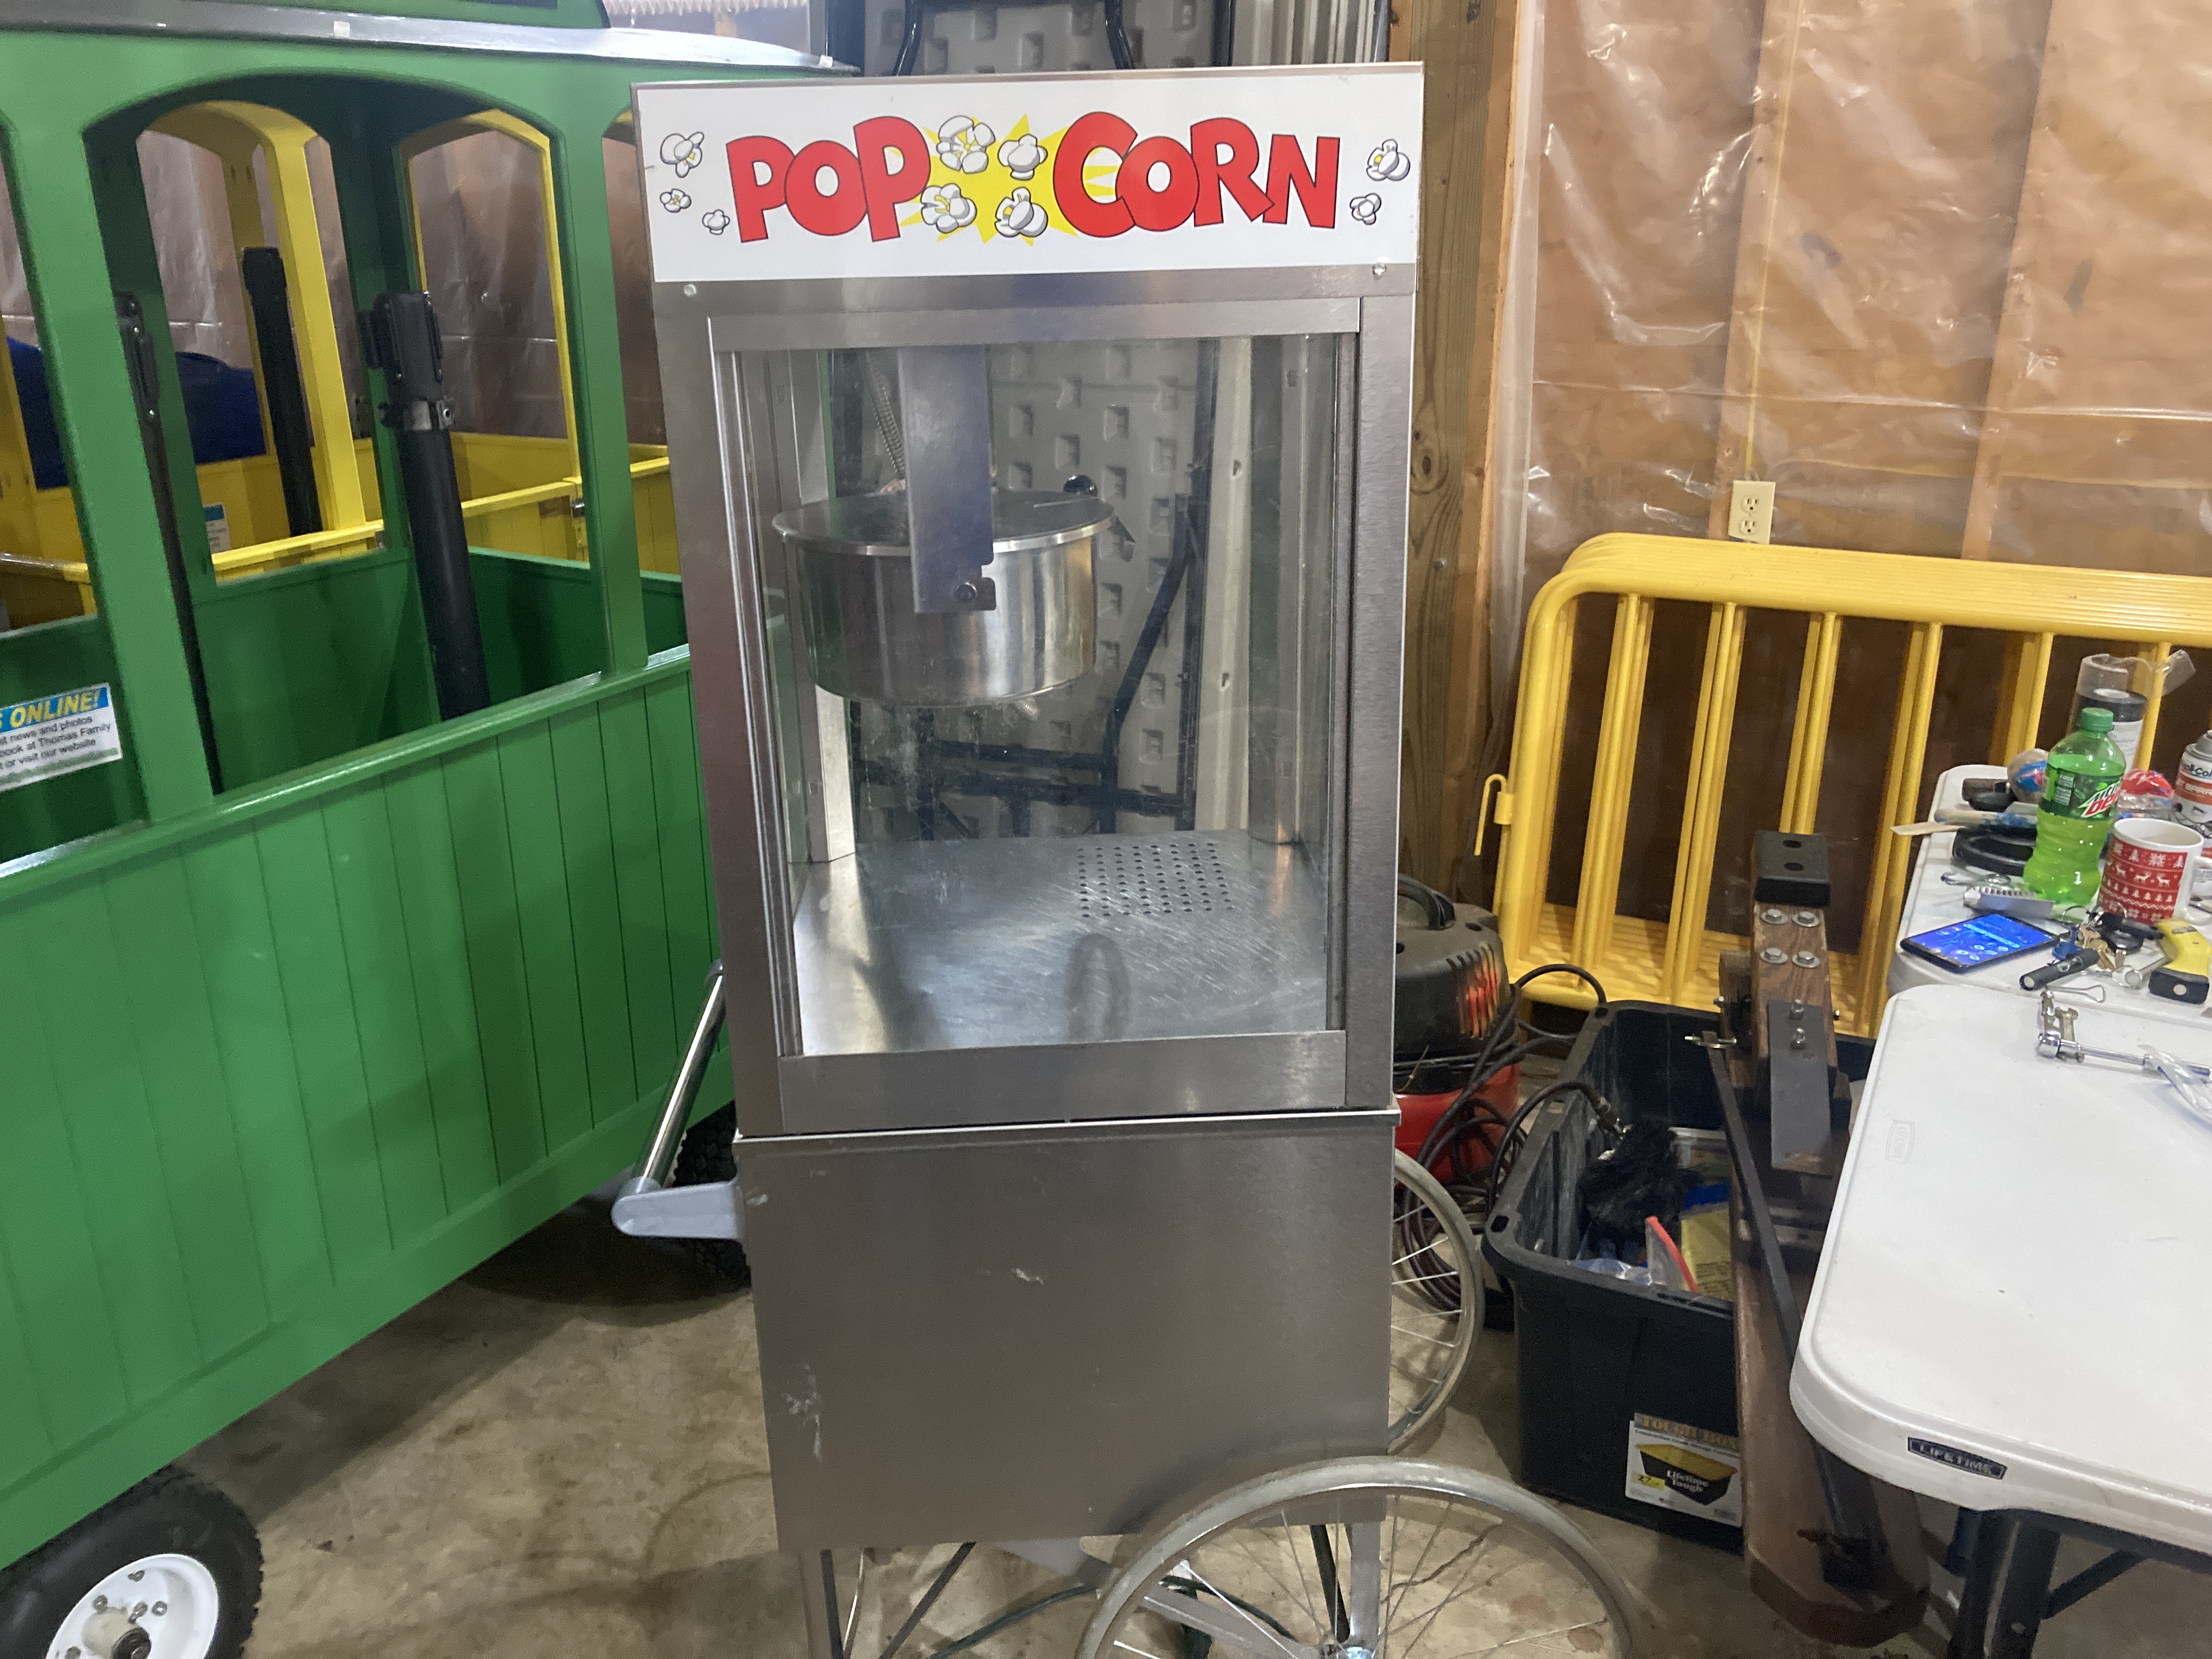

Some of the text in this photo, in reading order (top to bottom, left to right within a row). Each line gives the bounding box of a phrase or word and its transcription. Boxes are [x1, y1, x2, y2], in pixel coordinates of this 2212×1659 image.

[725, 111, 1340, 243] POP CORN
[10, 689, 101, 728] ONLINE!
[10, 730, 37, 741] news
[39, 724, 57, 735] and
[60, 716, 92, 730] photos
[38, 733, 78, 747] Thomas
[80, 723, 111, 736] Family
[59, 738, 96, 753] website
